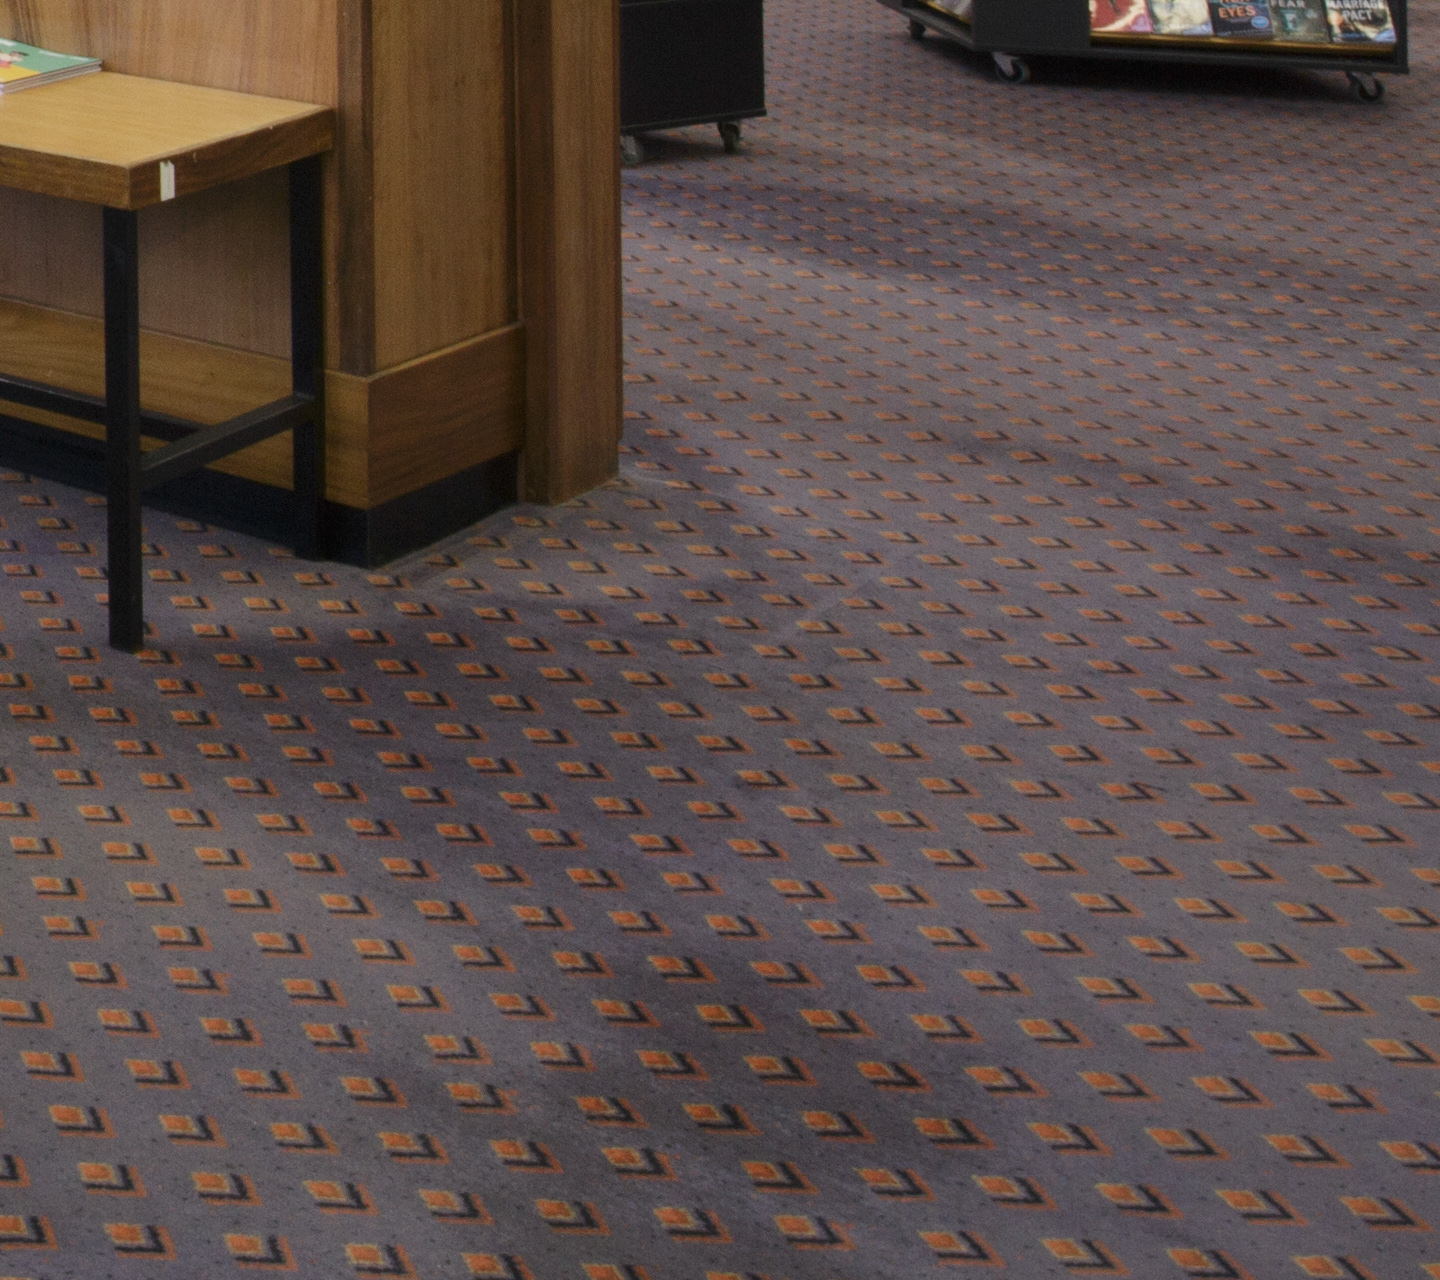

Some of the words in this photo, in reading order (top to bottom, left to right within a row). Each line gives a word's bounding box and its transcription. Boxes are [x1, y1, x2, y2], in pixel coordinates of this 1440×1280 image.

[1270, 0, 1306, 9] FEAR
[1218, 5, 1257, 19] EYES
[1341, 9, 1373, 21] PACT
